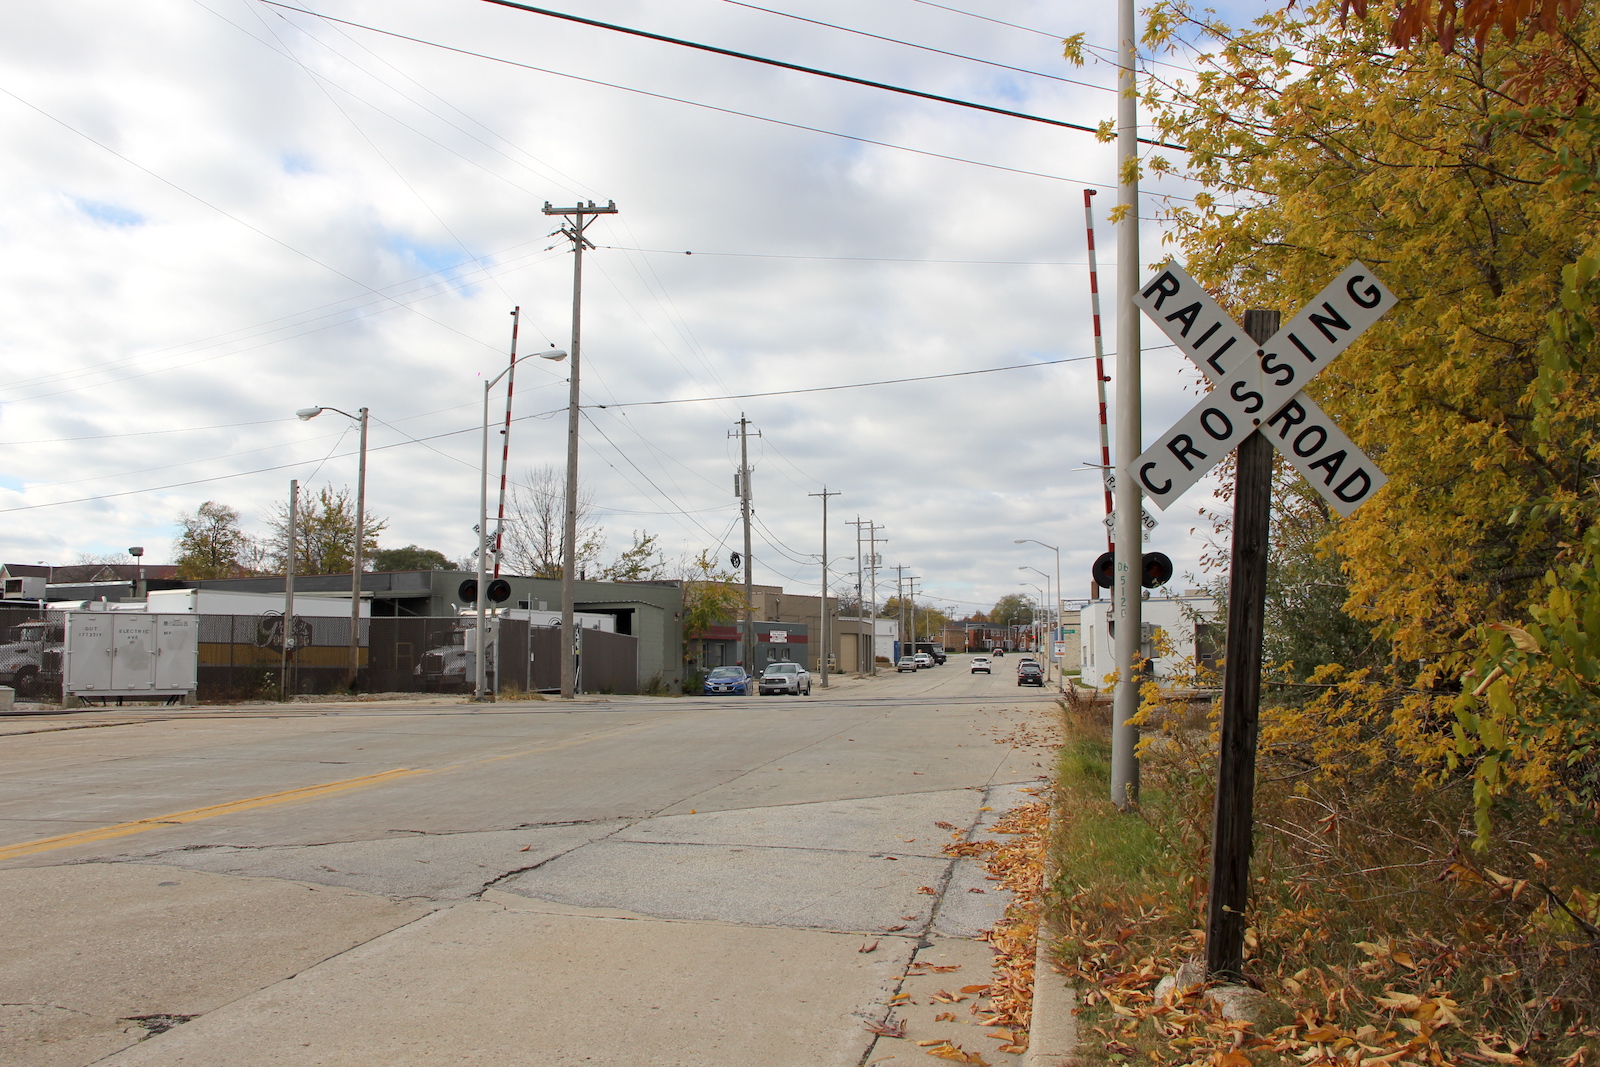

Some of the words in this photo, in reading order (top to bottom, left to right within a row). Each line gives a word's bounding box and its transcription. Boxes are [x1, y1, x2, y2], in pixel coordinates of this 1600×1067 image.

[1139, 275, 1382, 495] CROSSING
[1142, 271, 1237, 376] RAIL
[1267, 399, 1372, 503] ROAD
[1118, 562, 1129, 571] D6
